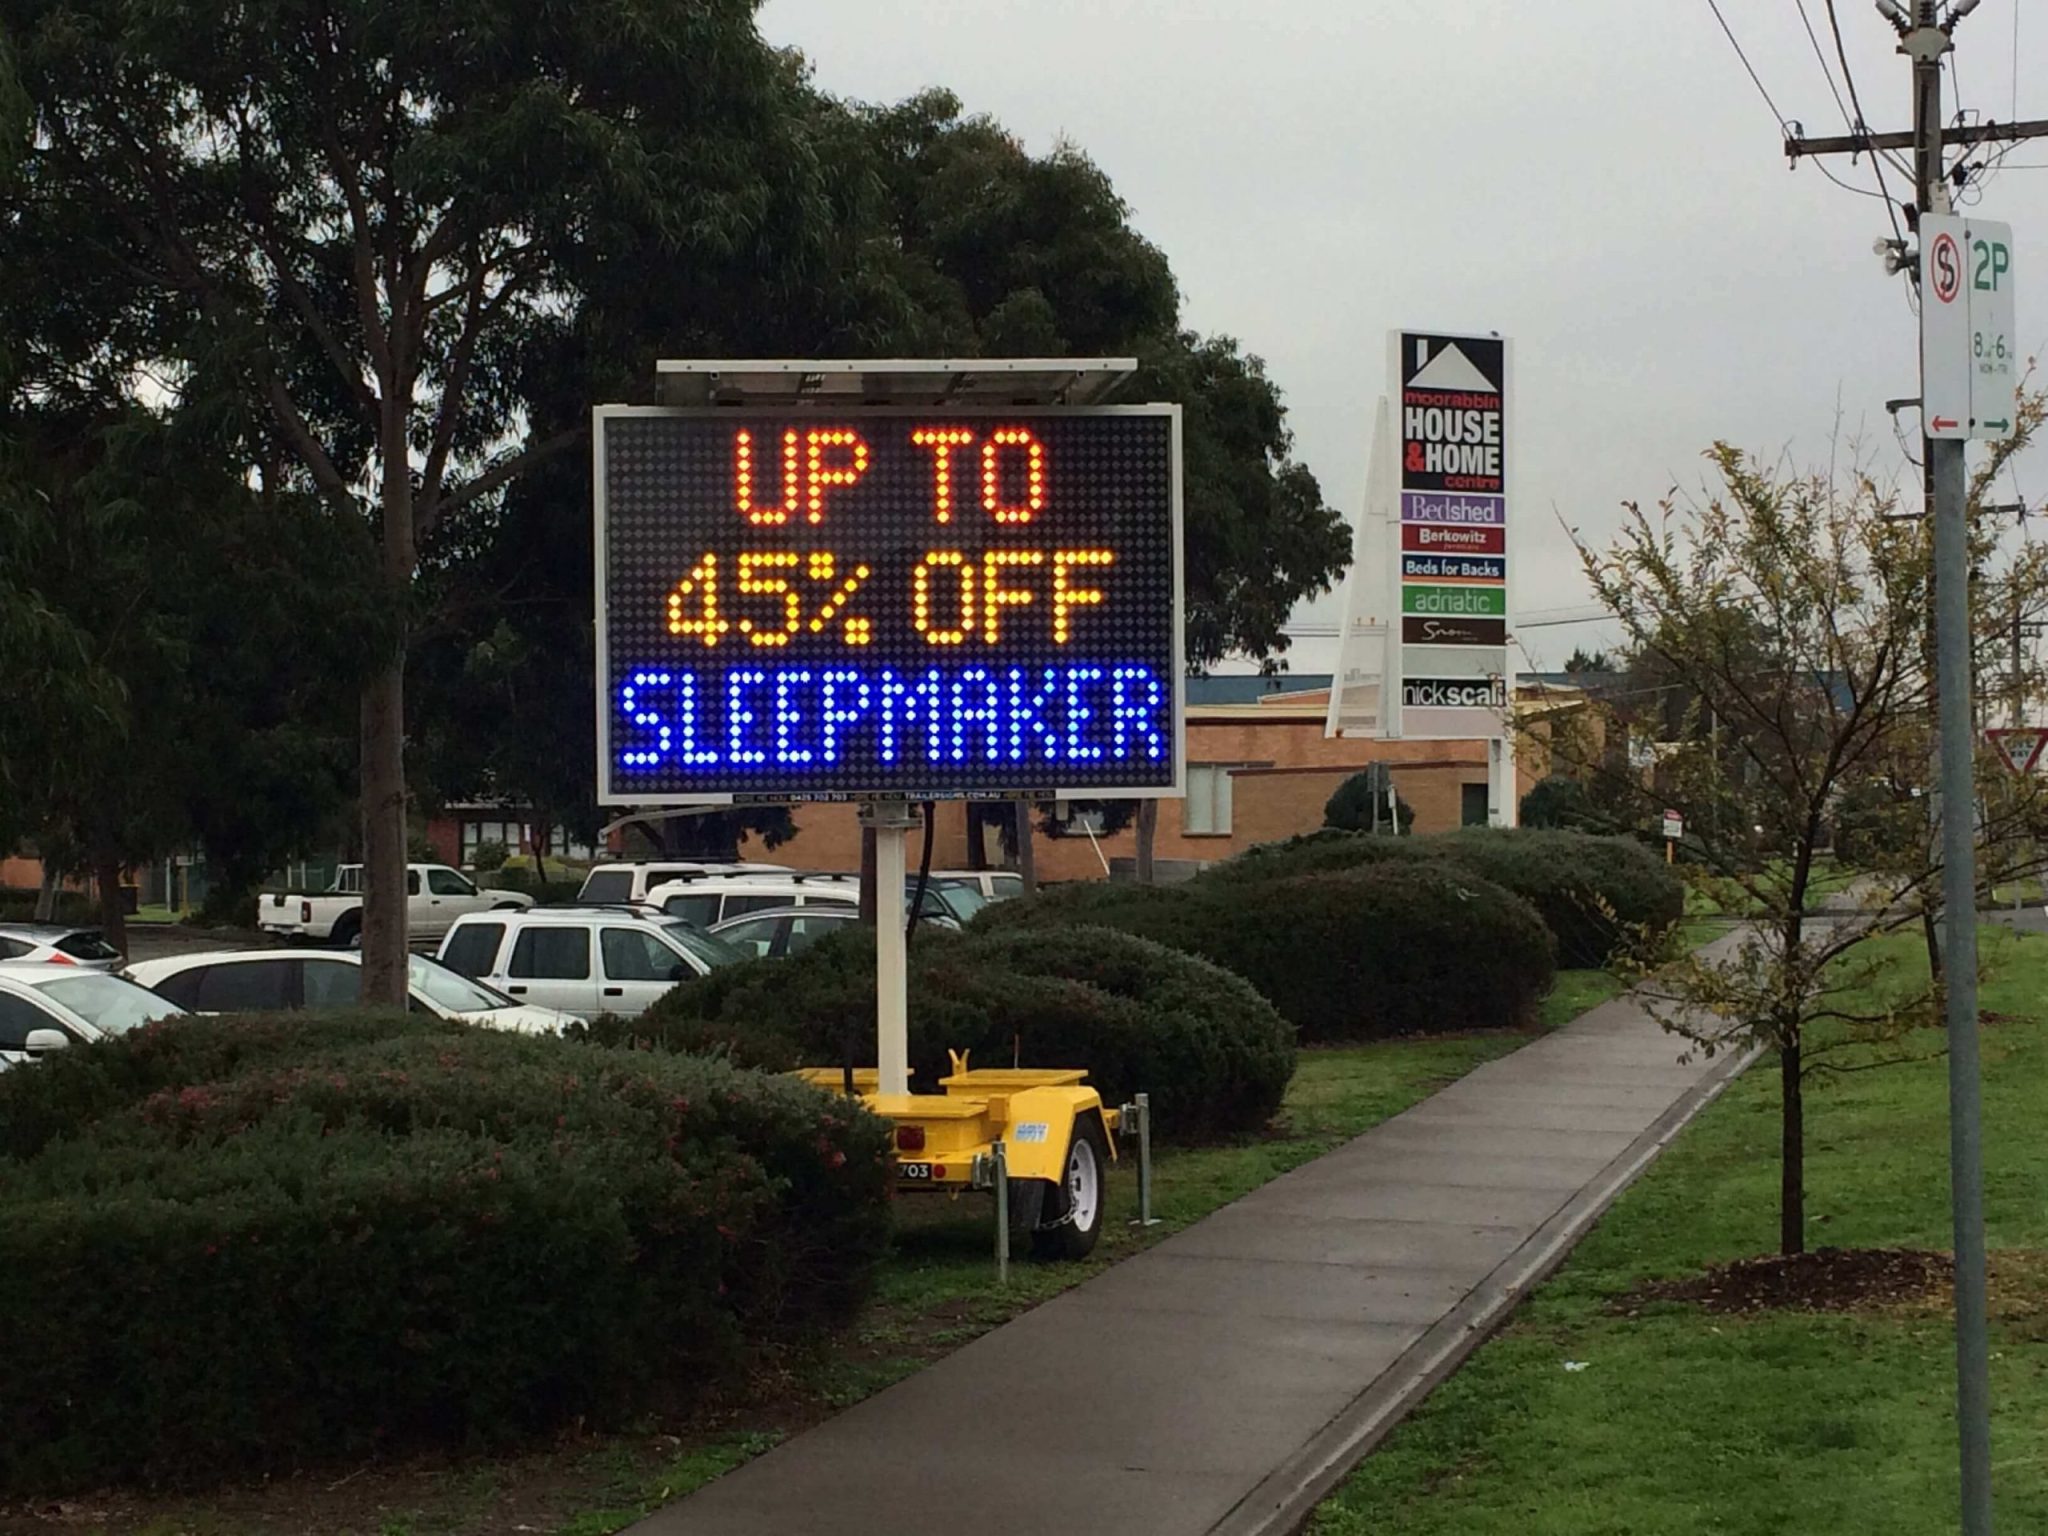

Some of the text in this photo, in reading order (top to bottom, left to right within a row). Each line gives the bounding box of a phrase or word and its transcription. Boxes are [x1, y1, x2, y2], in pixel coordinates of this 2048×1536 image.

[1973, 240, 2009, 291] 2P
[1405, 391, 1500, 409] moorabbin
[1405, 406, 1500, 444] HOUSE
[735, 427, 1045, 525] UP TO
[1411, 495, 1496, 523] Bedshed
[1419, 527, 1487, 544] Berkowitz
[1406, 559, 1500, 577] Beds for Backs
[665, 548, 1116, 648] 45% OFF
[1415, 588, 1491, 613] adriatic
[617, 662, 1165, 767] SLEEPMAKER
